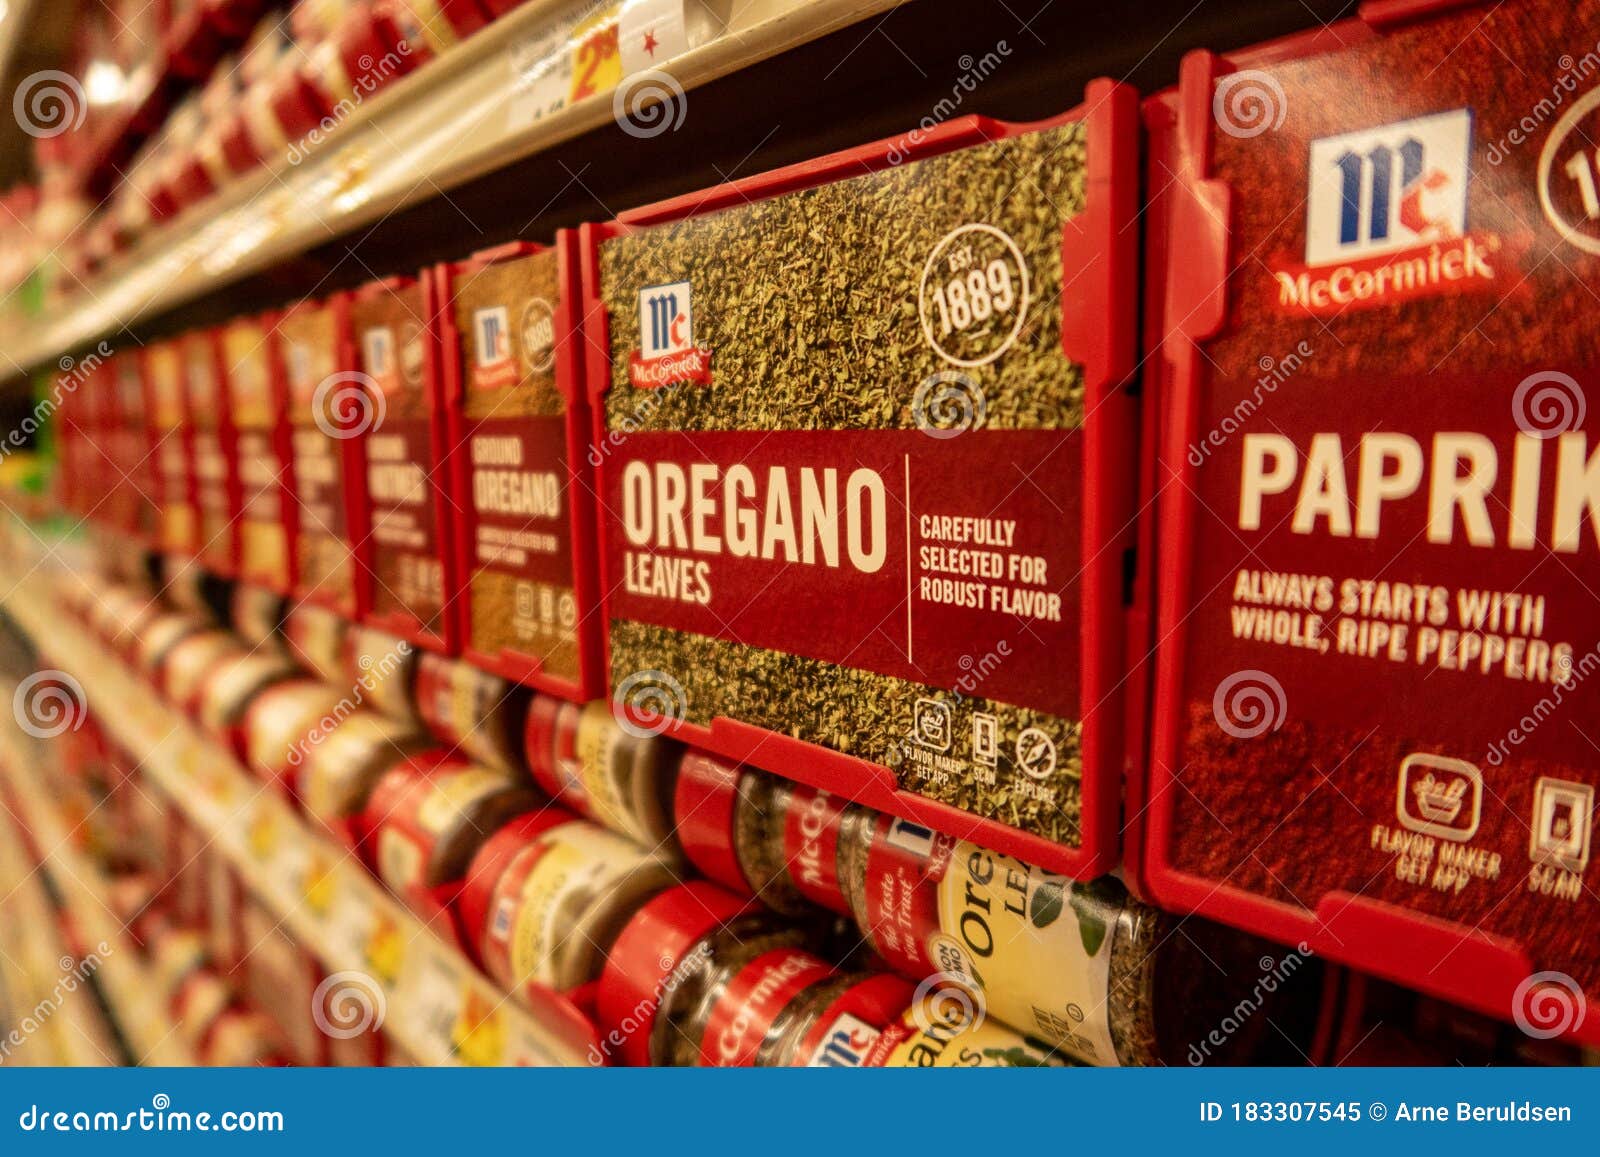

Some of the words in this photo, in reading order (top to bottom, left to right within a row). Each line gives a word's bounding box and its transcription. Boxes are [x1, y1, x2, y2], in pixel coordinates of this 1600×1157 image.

[1276, 236, 1495, 307] McCormick
[932, 259, 1014, 335] 1889
[473, 469, 560, 519] OREGANO
[623, 460, 887, 574] OREGANO
[920, 514, 1016, 548] CAREFULLY
[625, 551, 711, 604] LEAVES
[920, 545, 1004, 579] SELECTED
[1008, 554, 1047, 586] FOR
[920, 576, 987, 610] ROBUST
[991, 585, 1061, 622] FLAVOR
[1233, 569, 1334, 612] ALWAYS
[1340, 578, 1450, 626] STARTS
[1458, 588, 1545, 637] WITH
[1231, 605, 1330, 654] WHOLE,
[1337, 617, 1409, 662] RIPE
[1416, 626, 1573, 686] PEPPERS
[904, 745, 933, 766] FLAVOR
[935, 753, 962, 775] MAKER
[916, 765, 932, 782] GET
[933, 769, 949, 786] APP
[974, 766, 997, 786] SCAN
[1371, 824, 1435, 860] FLAVOR
[1438, 841, 1501, 880] MAKER
[1395, 856, 1430, 885] GET
[1431, 865, 1470, 896] APP
[879, 873, 895, 920] Taste
[959, 848, 996, 958] Ore
[1527, 862, 1584, 903] SCAN
